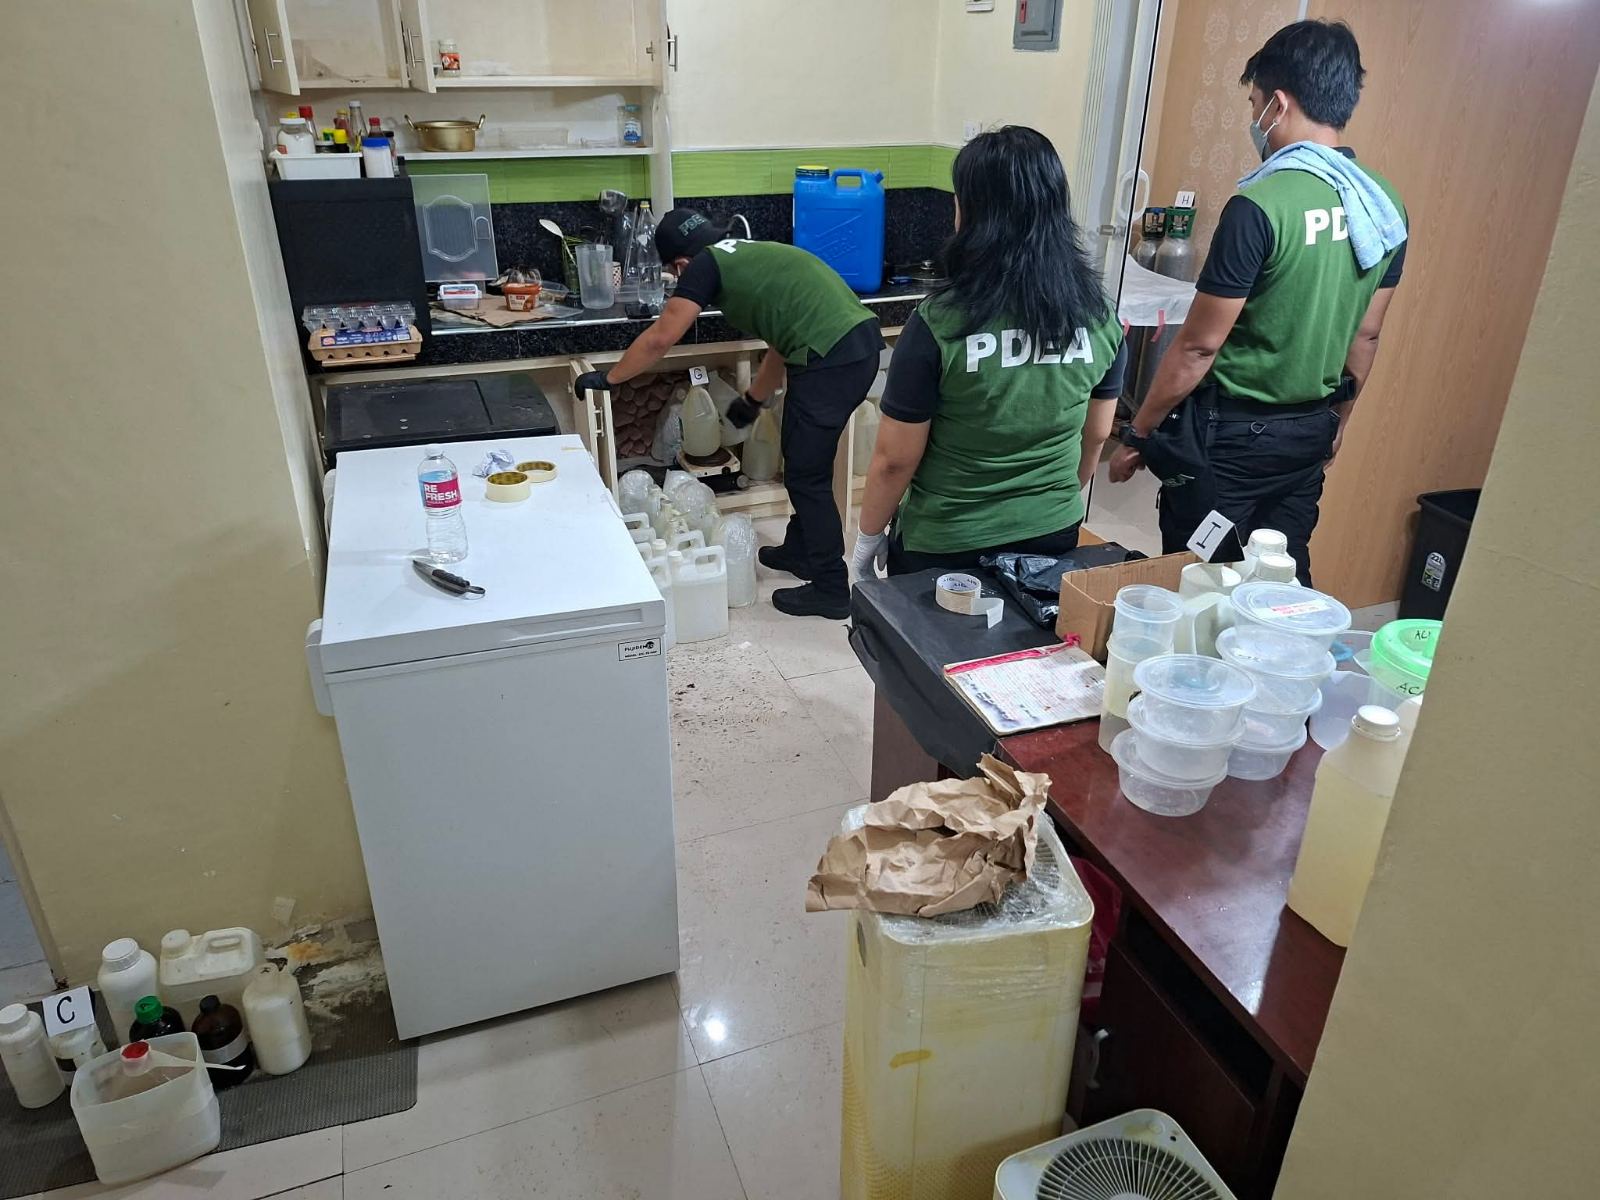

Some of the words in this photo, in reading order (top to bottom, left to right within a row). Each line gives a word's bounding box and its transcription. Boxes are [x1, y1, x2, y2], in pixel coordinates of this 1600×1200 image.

[1181, 194, 1190, 205] H
[966, 326, 1094, 373] PDEA
[693, 367, 703, 380] G
[424, 484, 438, 493] RE
[425, 489, 457, 501] FRESH
[1195, 521, 1222, 549] I
[56, 995, 75, 1024] C
